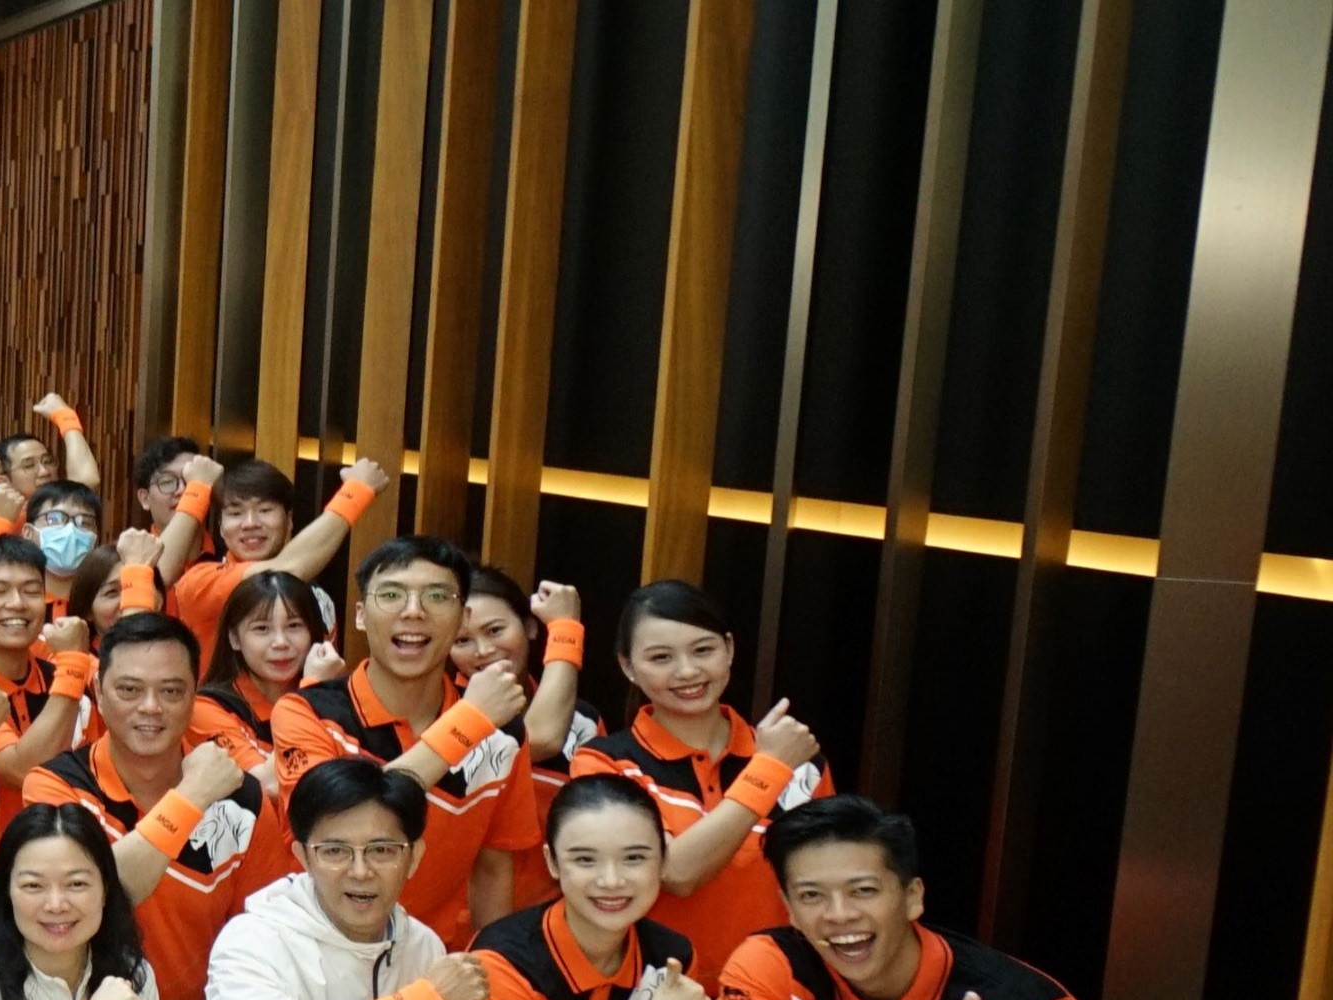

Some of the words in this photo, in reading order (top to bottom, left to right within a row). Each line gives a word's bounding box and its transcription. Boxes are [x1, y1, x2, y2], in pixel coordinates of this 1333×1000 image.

[449, 727, 474, 749] MGM
[743, 774, 768, 791] MGM
[156, 814, 177, 834] MGM
